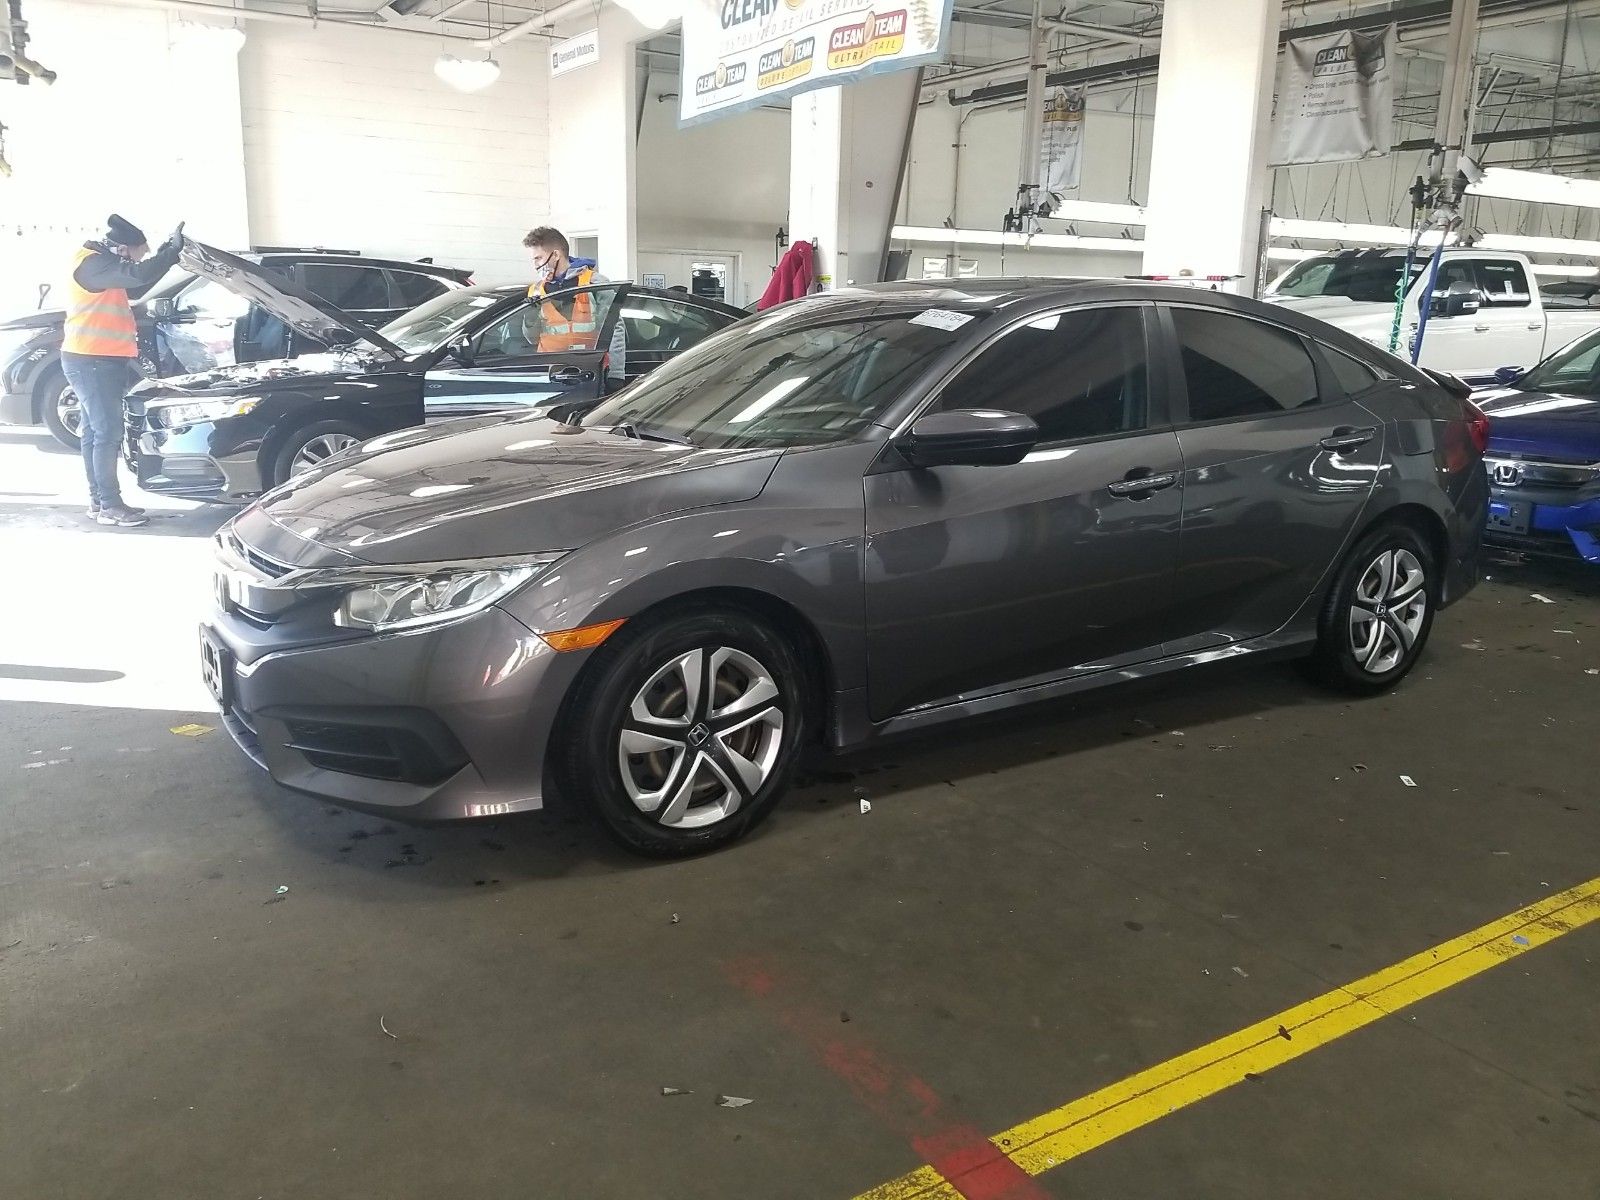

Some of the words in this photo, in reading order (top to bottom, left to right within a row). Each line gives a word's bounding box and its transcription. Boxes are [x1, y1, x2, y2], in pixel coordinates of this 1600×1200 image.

[820, 0, 872, 17] SERVIC
[833, 27, 864, 49] CLEAN
[875, 14, 904, 36] TEAM
[760, 52, 782, 73] CLEAN
[795, 38, 814, 60] TEAM
[834, 49, 864, 64] ULTRA
[1317, 48, 1347, 63] CLEAN
[697, 75, 716, 93] CLEAN
[727, 64, 745, 83] TEAM
